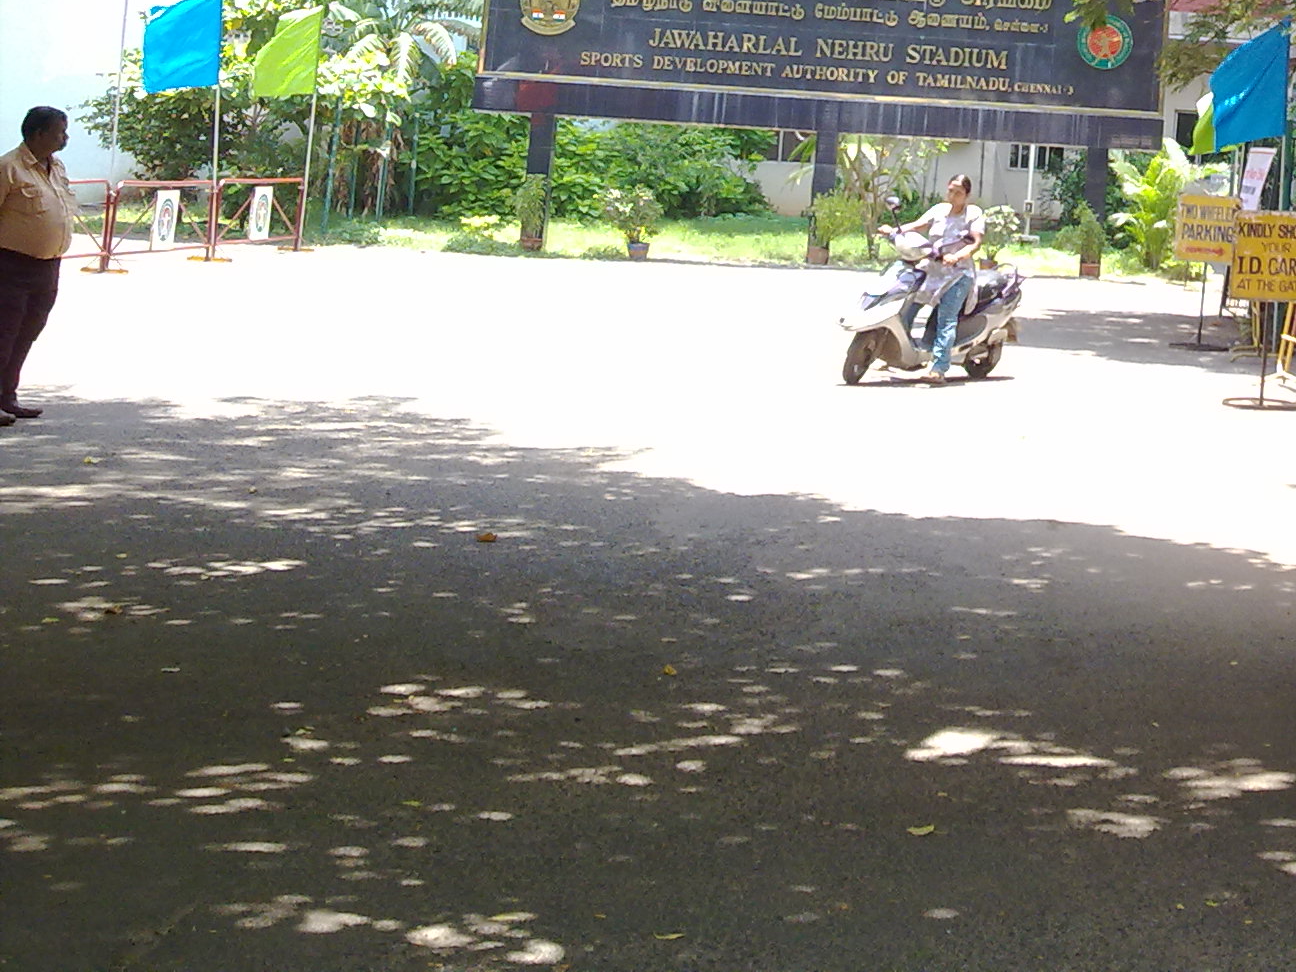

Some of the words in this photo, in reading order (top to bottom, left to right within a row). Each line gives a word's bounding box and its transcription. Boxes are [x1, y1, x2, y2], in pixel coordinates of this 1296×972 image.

[814, 2, 899, 27] மேம்பாட்டு
[648, 28, 803, 57] JAWAHARLAL
[815, 38, 895, 62] NEHRU
[905, 44, 1009, 70] STADIUM
[580, 51, 644, 69] SPORTS
[652, 55, 776, 78] DEVELOPMENT
[781, 64, 879, 84] AUTHORITY
[886, 70, 908, 86] OF
[915, 72, 1012, 93] TAMILNADU,
[1180, 203, 1198, 220] TWO
[1181, 222, 1234, 243] PARKING
[1239, 221, 1276, 239] KINDLY
[1261, 241, 1292, 253] YOUR
[1236, 278, 1251, 290] AT
[1256, 278, 1274, 292] THE
